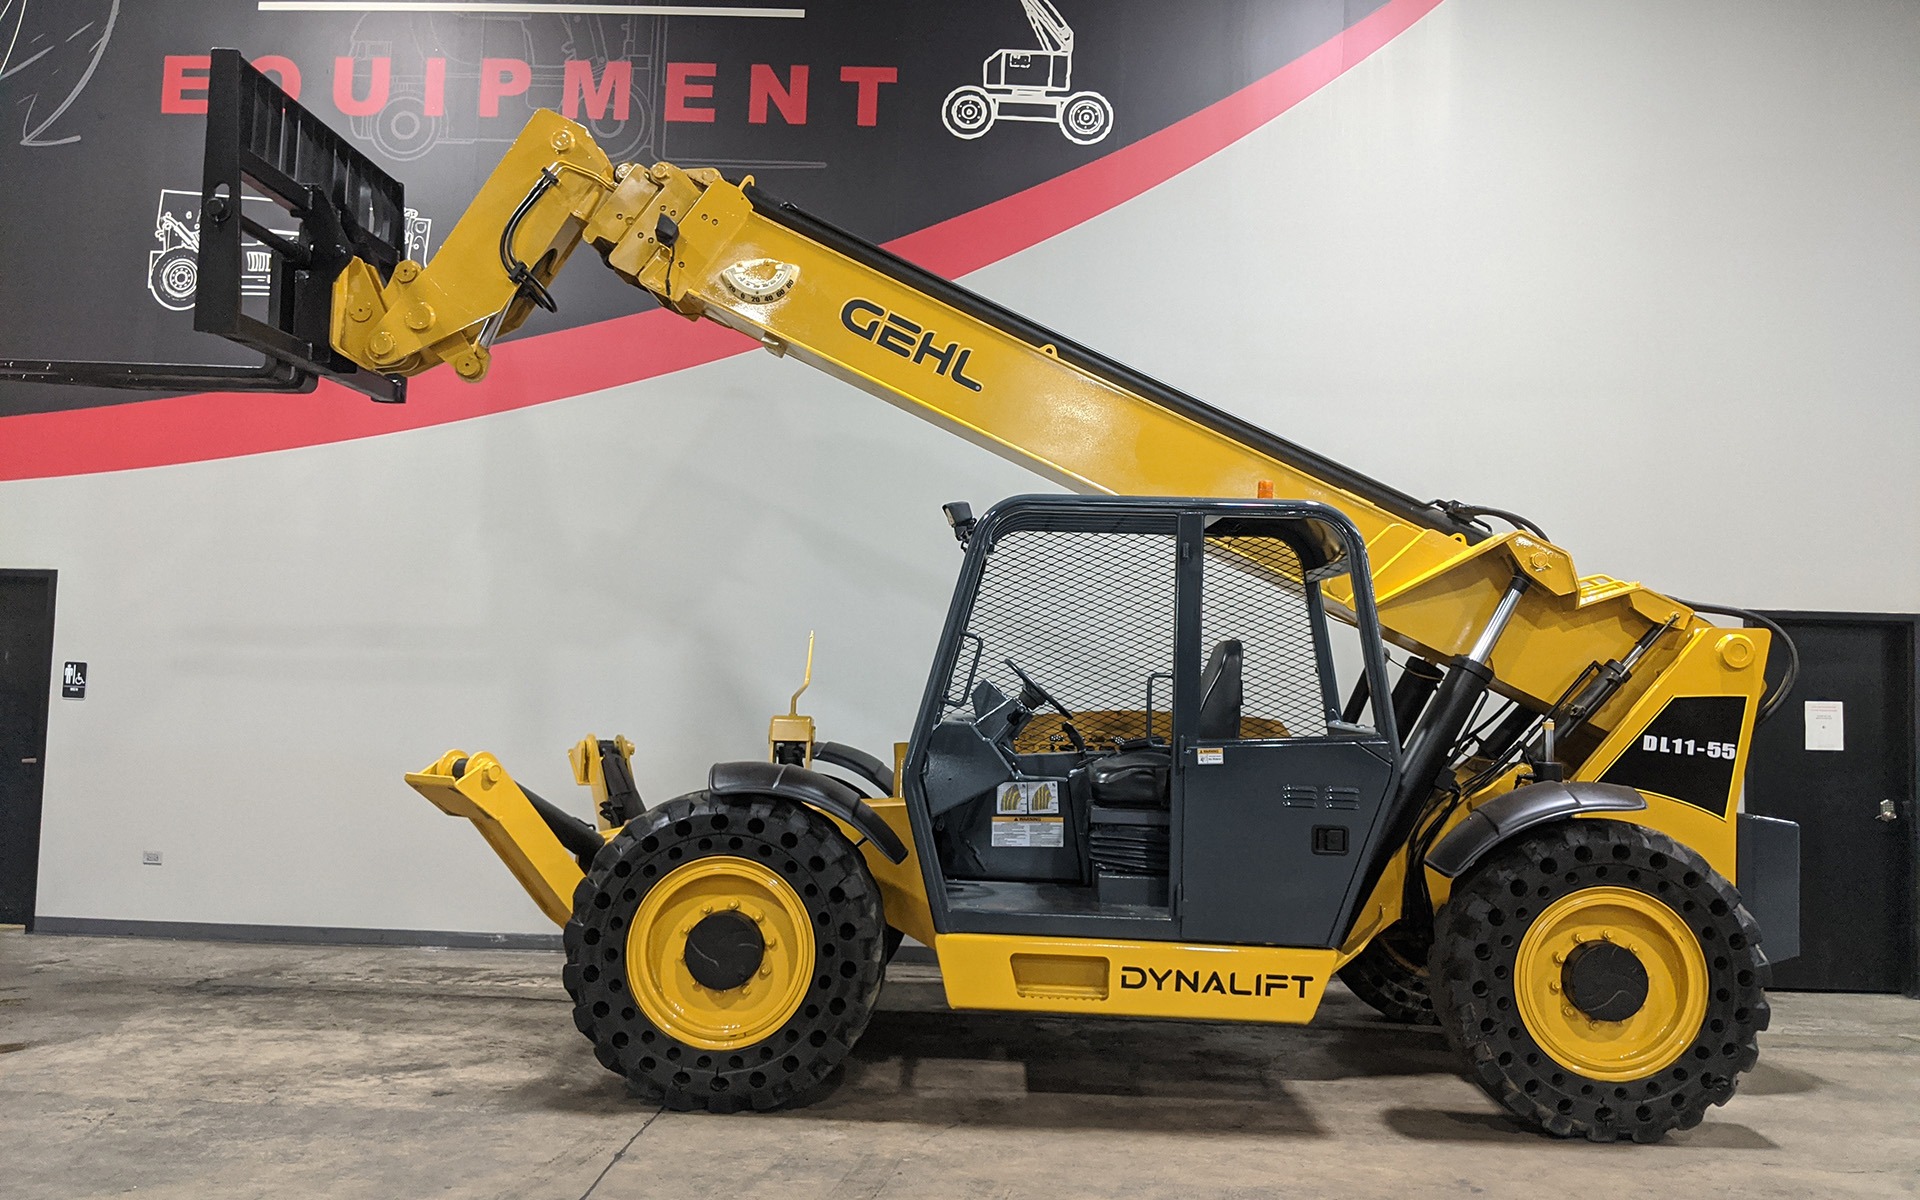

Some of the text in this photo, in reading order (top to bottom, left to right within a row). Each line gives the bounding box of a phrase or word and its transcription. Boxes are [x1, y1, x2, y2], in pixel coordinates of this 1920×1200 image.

[840, 298, 983, 393] GEHL
[1642, 734, 1736, 760] DL11-55
[1121, 966, 1314, 998] DYNALIFT
